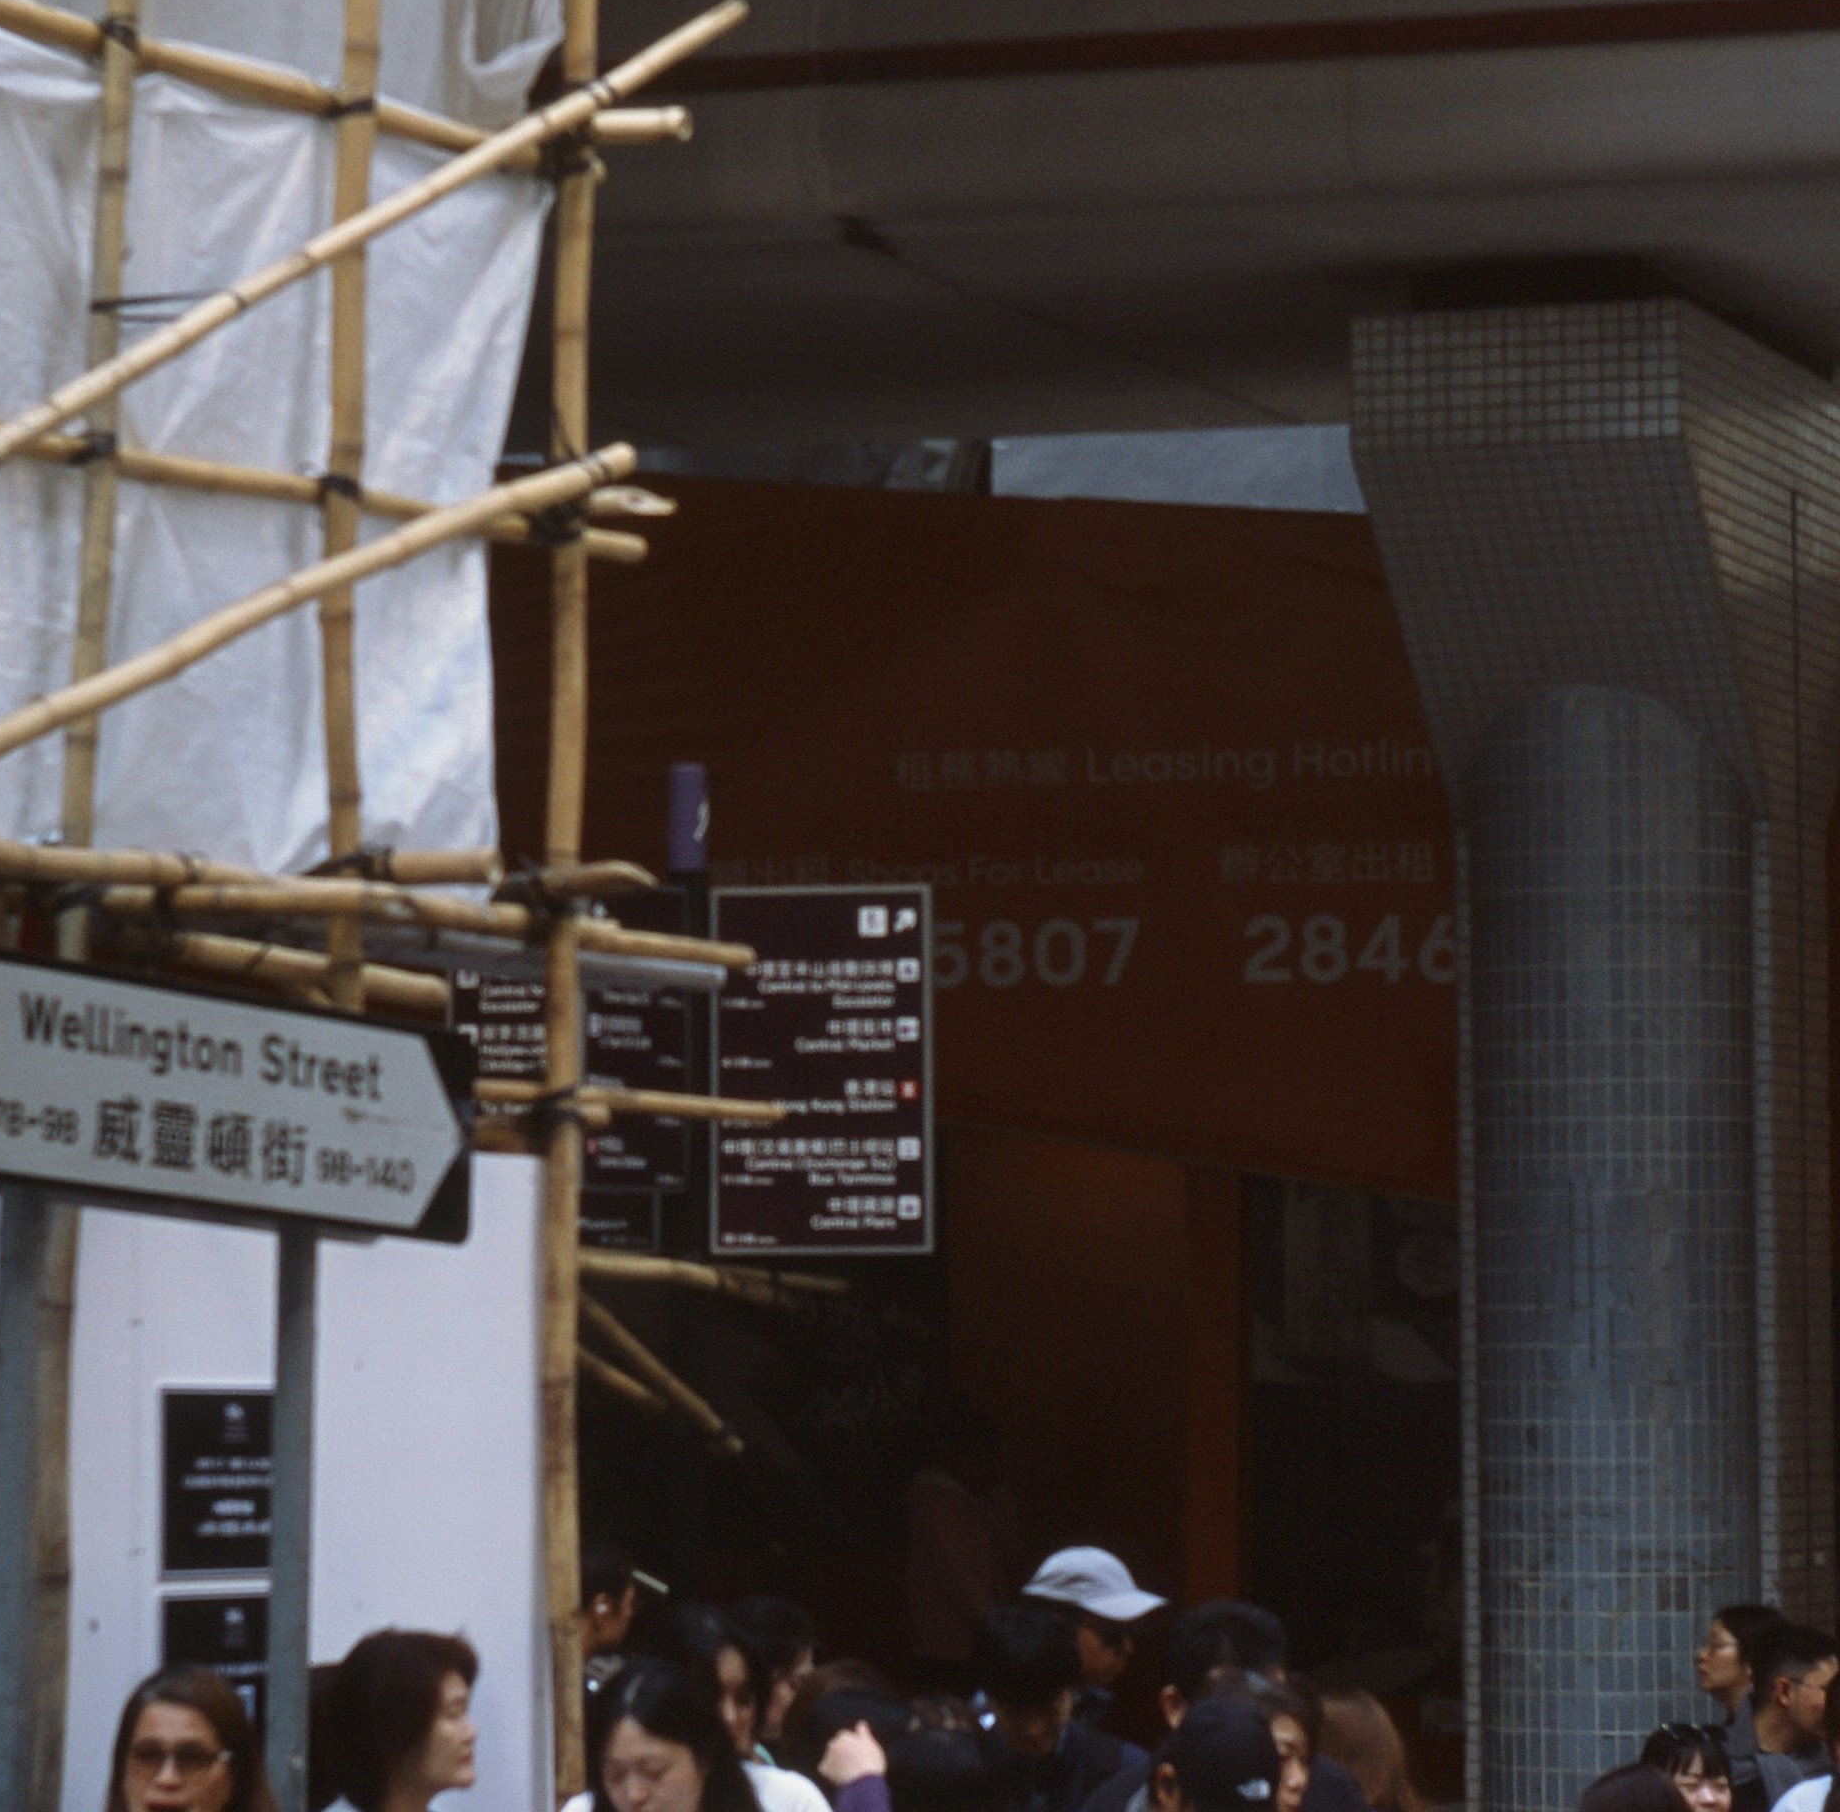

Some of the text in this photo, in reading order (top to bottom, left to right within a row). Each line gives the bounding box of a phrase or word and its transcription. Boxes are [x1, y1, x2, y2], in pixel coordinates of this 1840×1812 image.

[1086, 747, 1277, 790] Leasing
[1292, 738, 1434, 780] Hotlin
[1034, 855, 1144, 886] Lease
[1242, 914, 1458, 985] 2846
[20, 991, 383, 1102] Wellington Street
[92, 1094, 309, 1188] 威靈頓街
